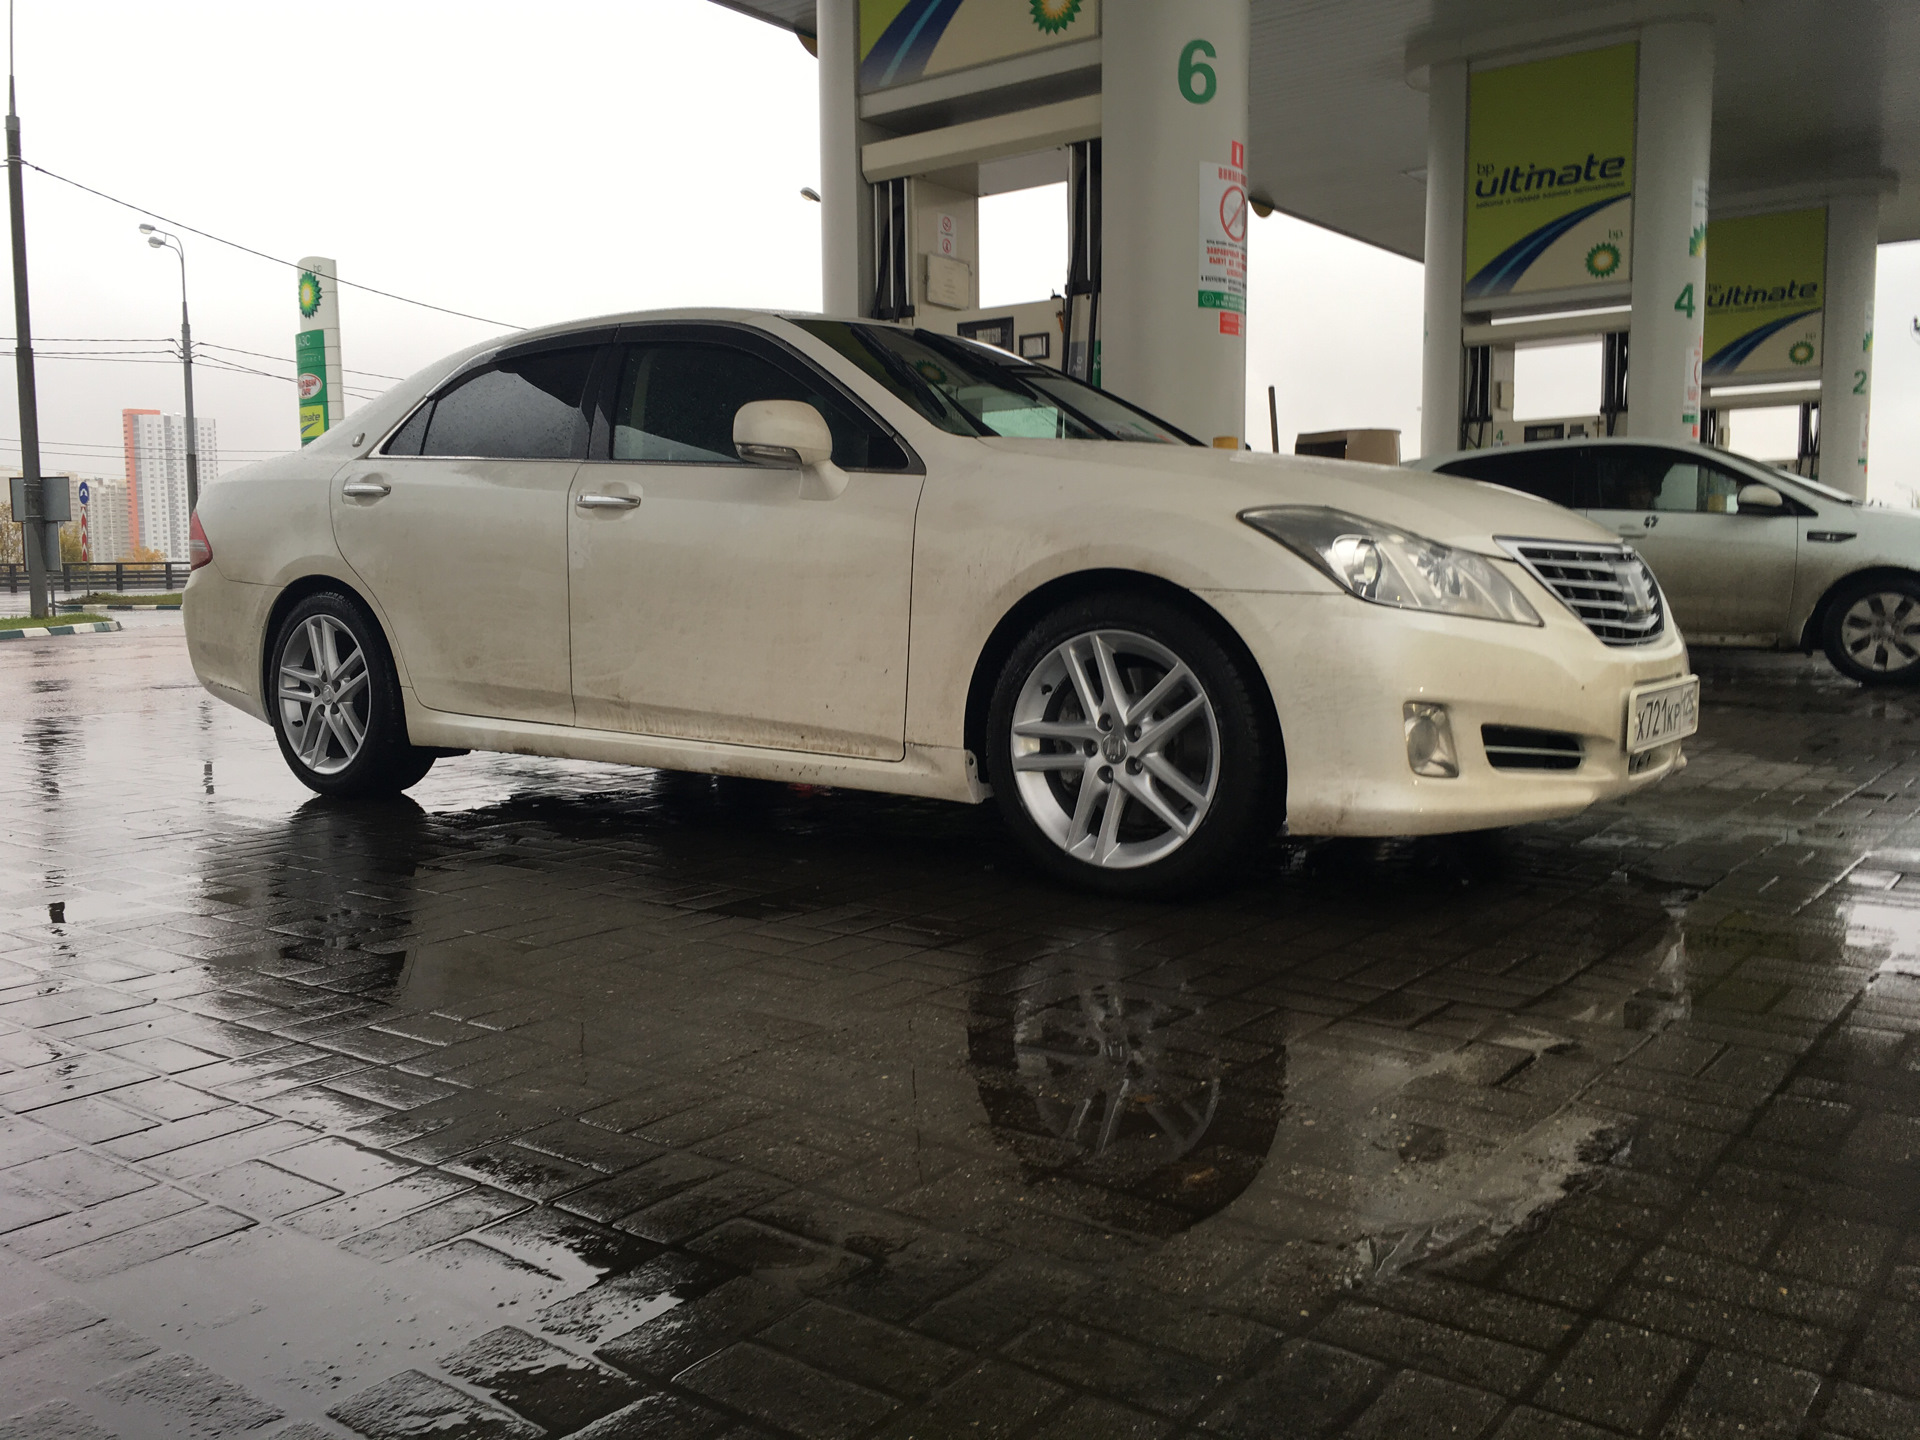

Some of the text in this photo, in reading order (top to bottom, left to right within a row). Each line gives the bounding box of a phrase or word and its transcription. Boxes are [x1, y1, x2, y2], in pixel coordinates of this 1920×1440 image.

[1177, 39, 1217, 105] 6
[1475, 153, 1626, 198] ultimate
[1476, 162, 1495, 177] bp
[1674, 283, 1696, 318] 4
[1707, 279, 1818, 307] ultimate
[1853, 370, 1868, 395] 2
